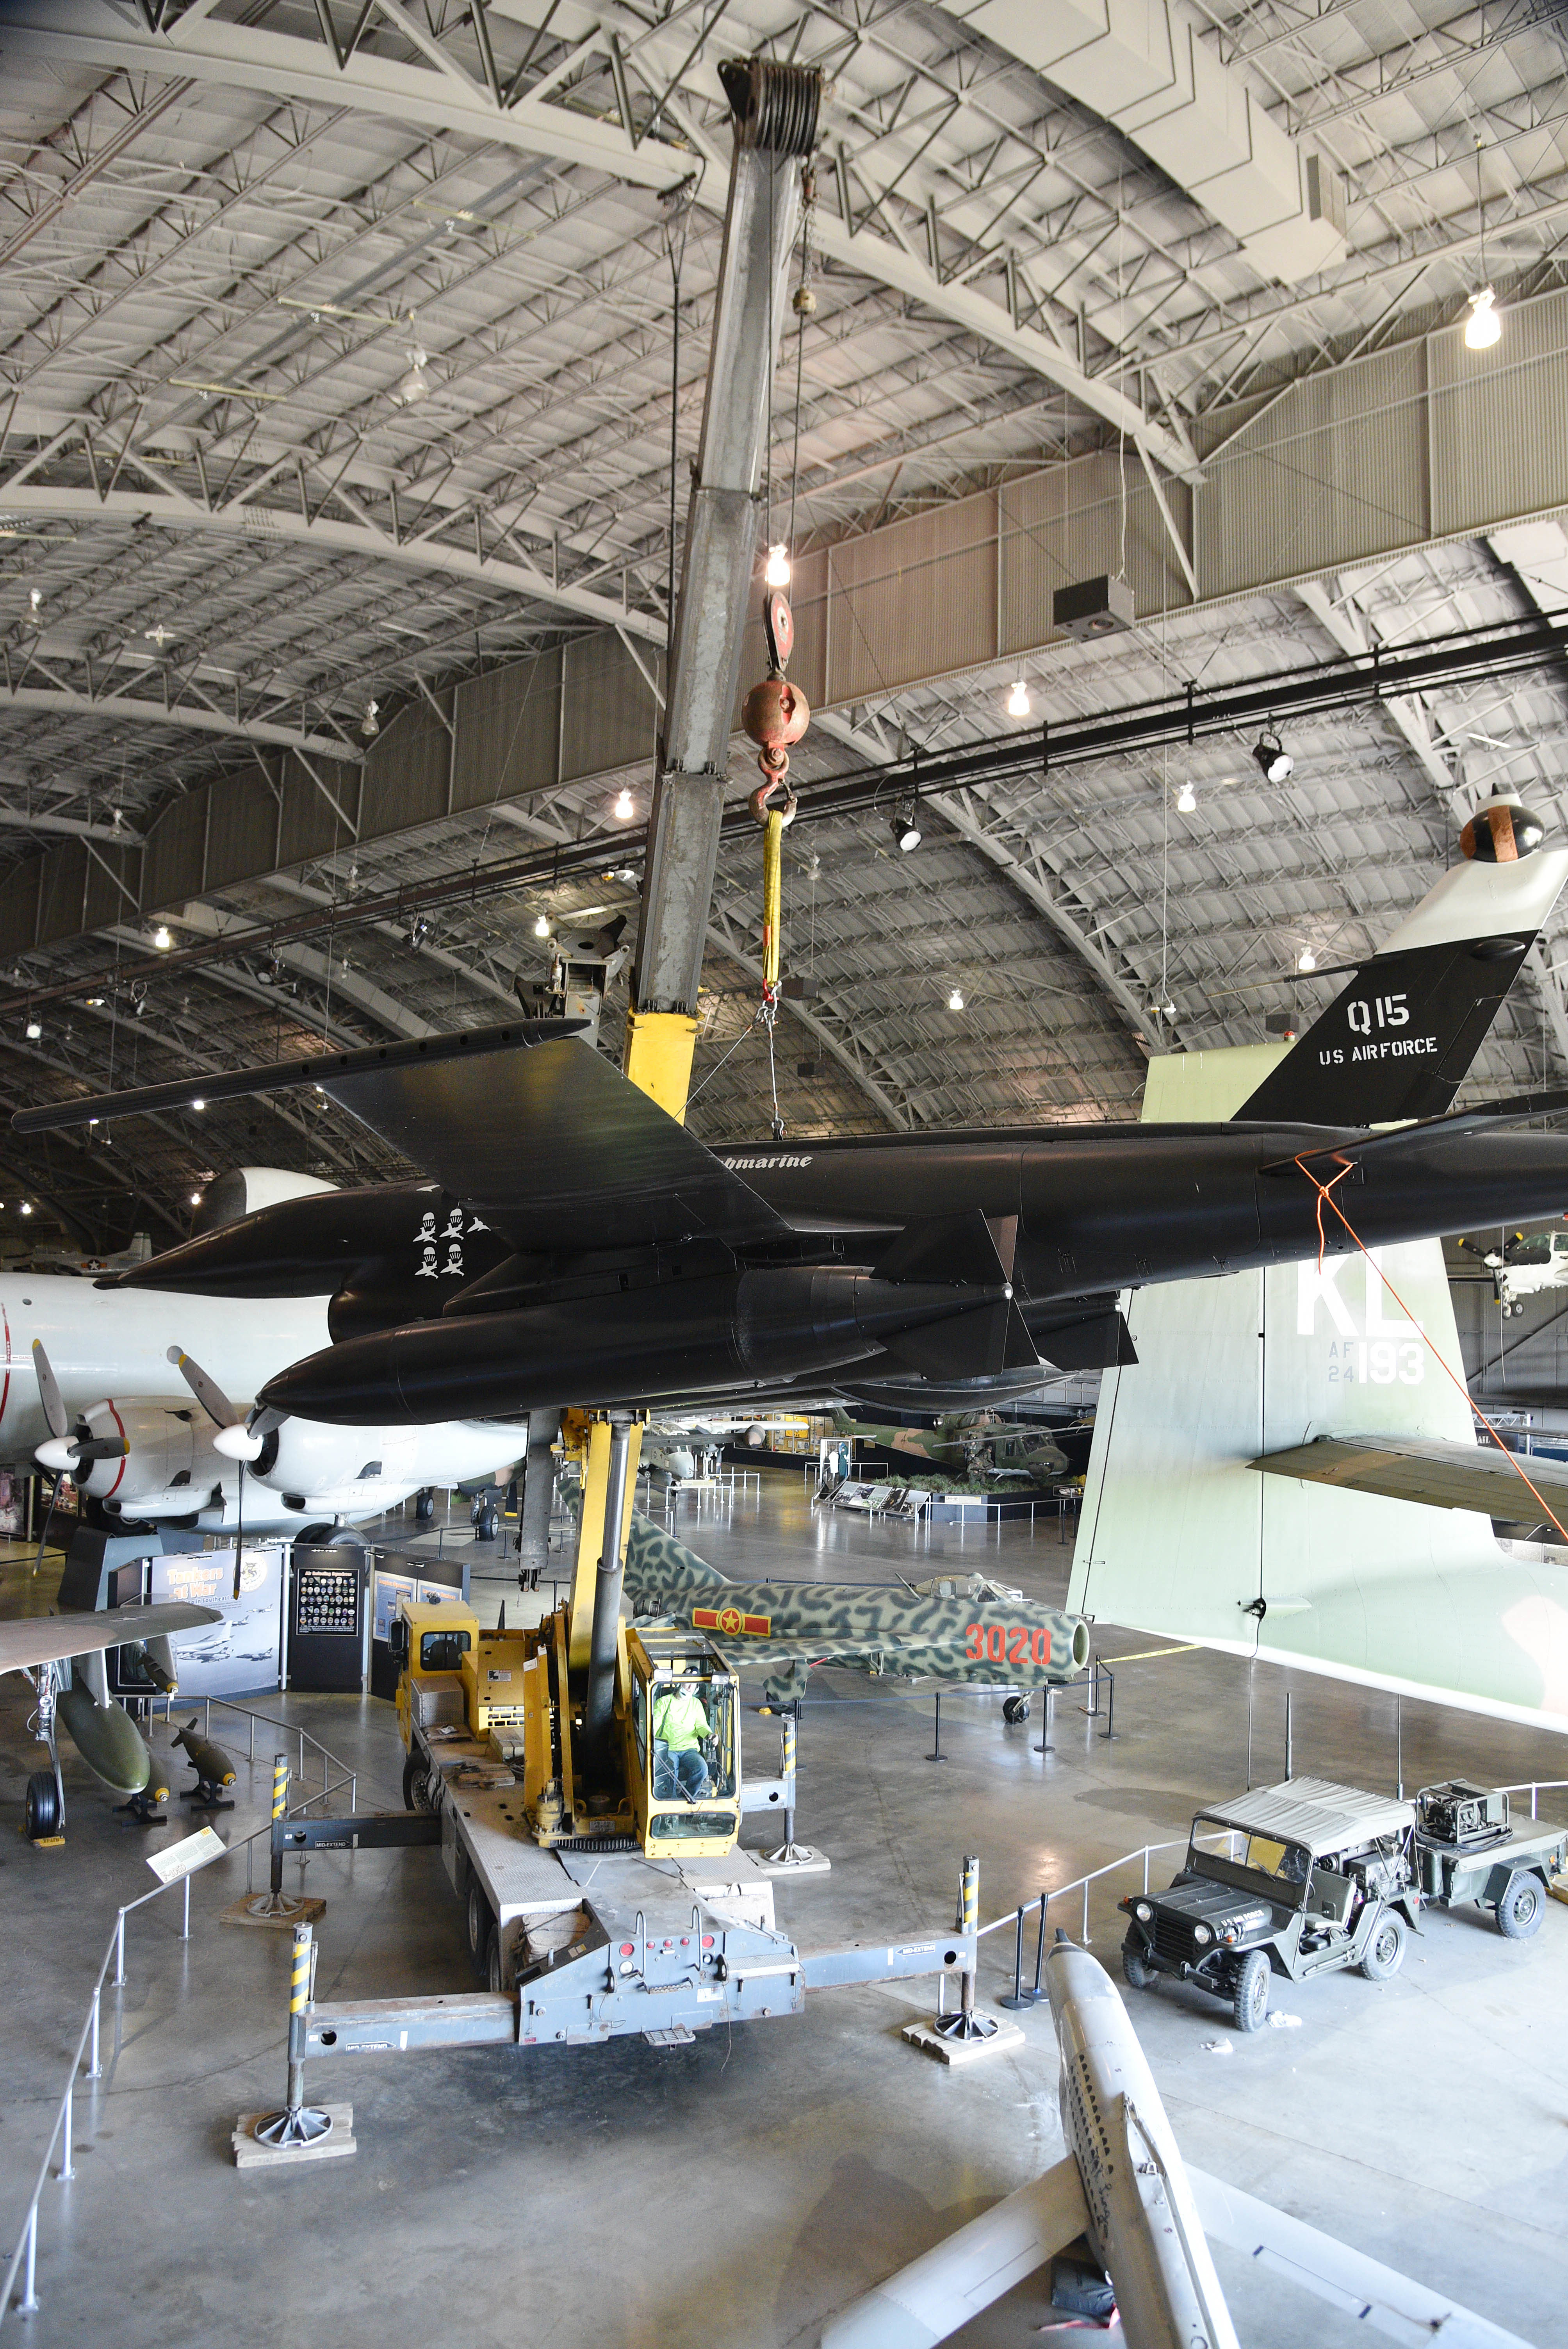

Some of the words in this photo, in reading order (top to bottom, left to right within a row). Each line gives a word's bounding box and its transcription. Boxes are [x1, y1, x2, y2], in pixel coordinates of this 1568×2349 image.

[1347, 994, 1409, 1035] Q15
[1319, 1049, 1343, 1065] US
[1352, 1044, 1378, 1061] AIR
[1380, 1037, 1438, 1058] FORCE
[722, 1155, 813, 1169] bmarine
[1297, 1246, 1424, 1338] KL
[1329, 1341, 1354, 1358] AF
[1328, 1365, 1354, 1382] 24
[1359, 1341, 1424, 1385] 193
[167, 1567, 224, 1585] Tankers
[190, 1582, 217, 1598] War
[966, 1624, 1051, 1665] 3020
[903, 1944, 935, 1954] MID-EXTEND
